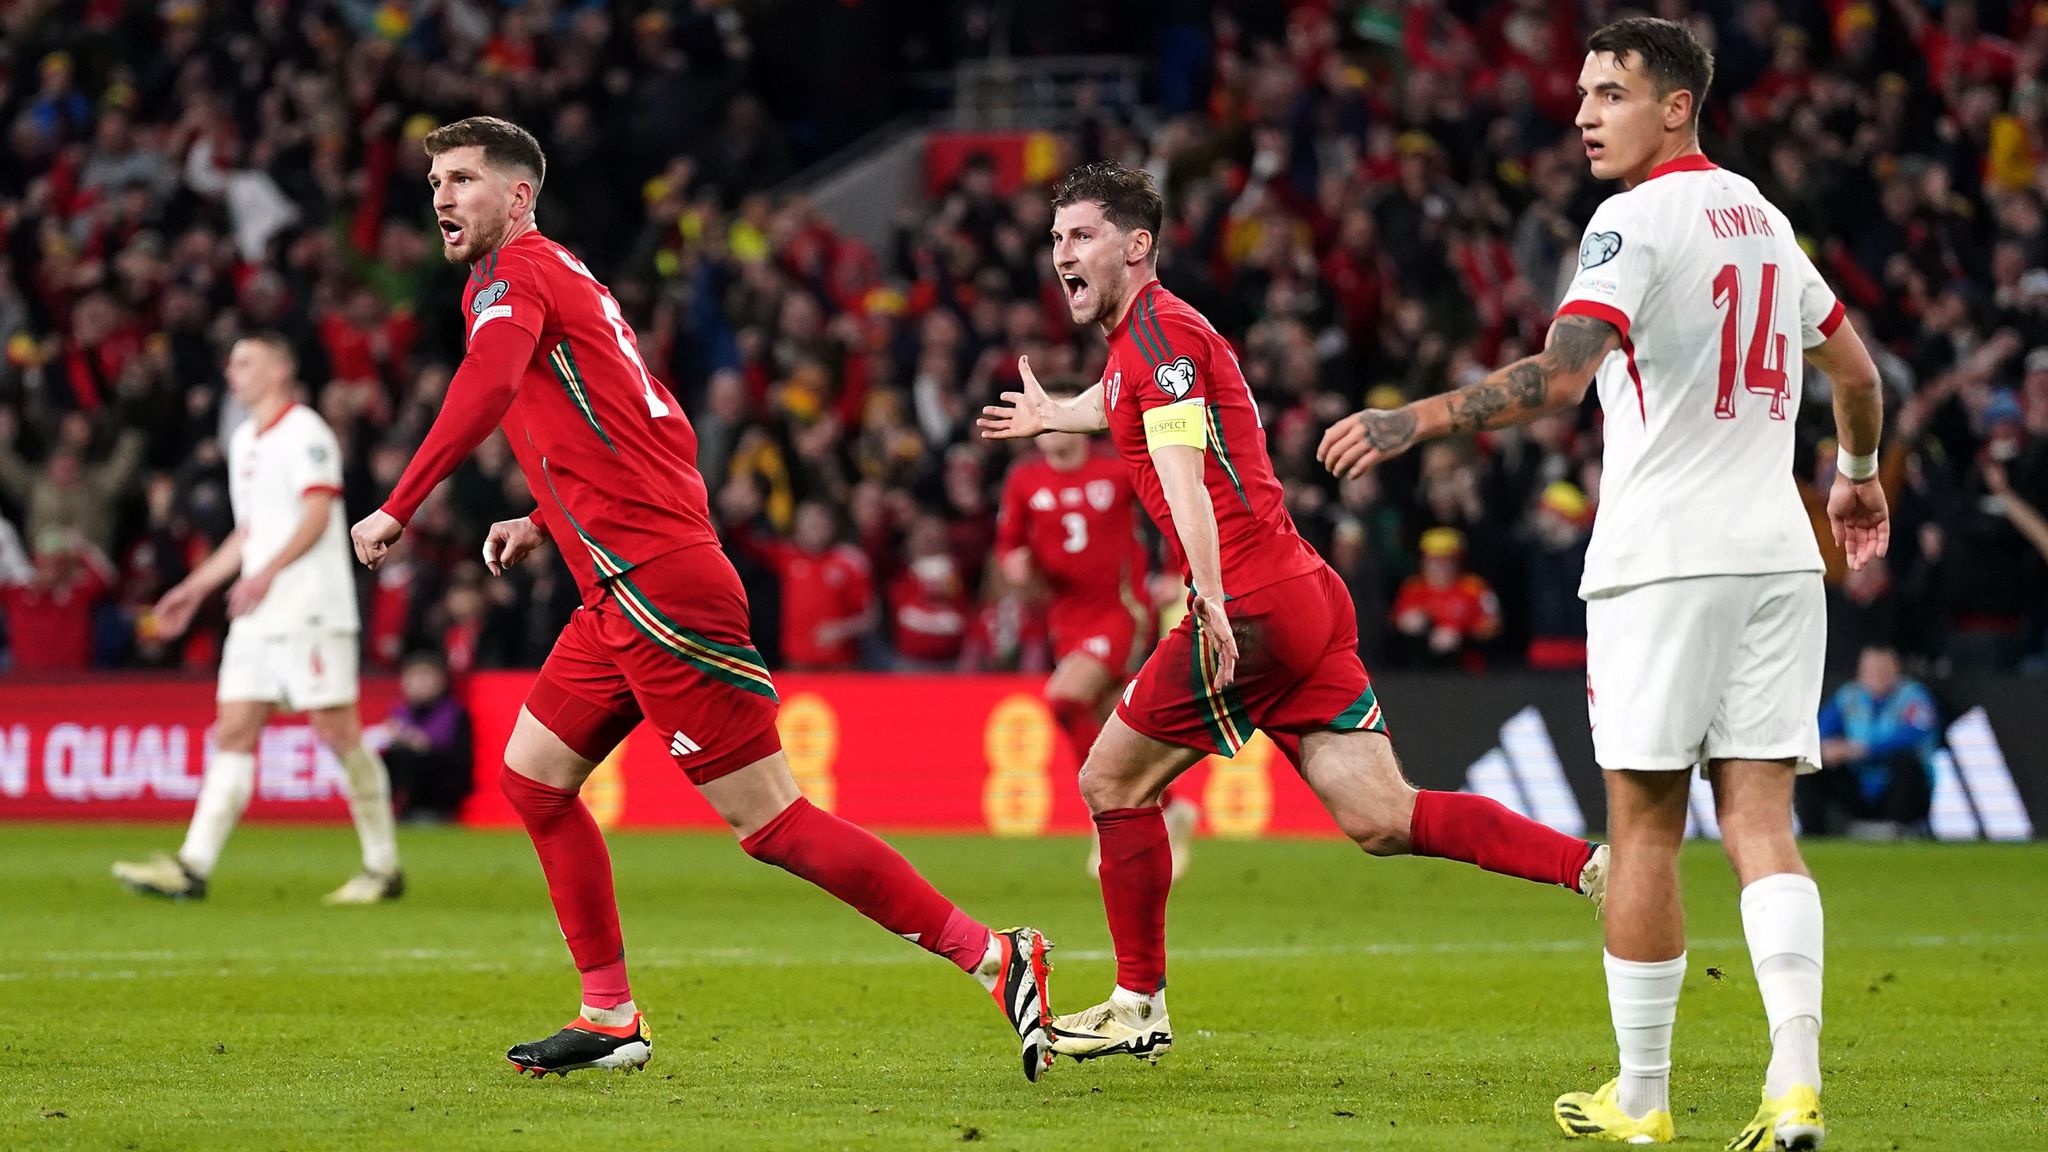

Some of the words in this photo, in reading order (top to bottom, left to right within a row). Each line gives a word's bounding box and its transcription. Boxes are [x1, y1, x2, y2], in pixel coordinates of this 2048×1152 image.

[1713, 263, 1790, 420] 14
[1150, 421, 1187, 433] RESPECT
[1061, 512, 1088, 554] 3
